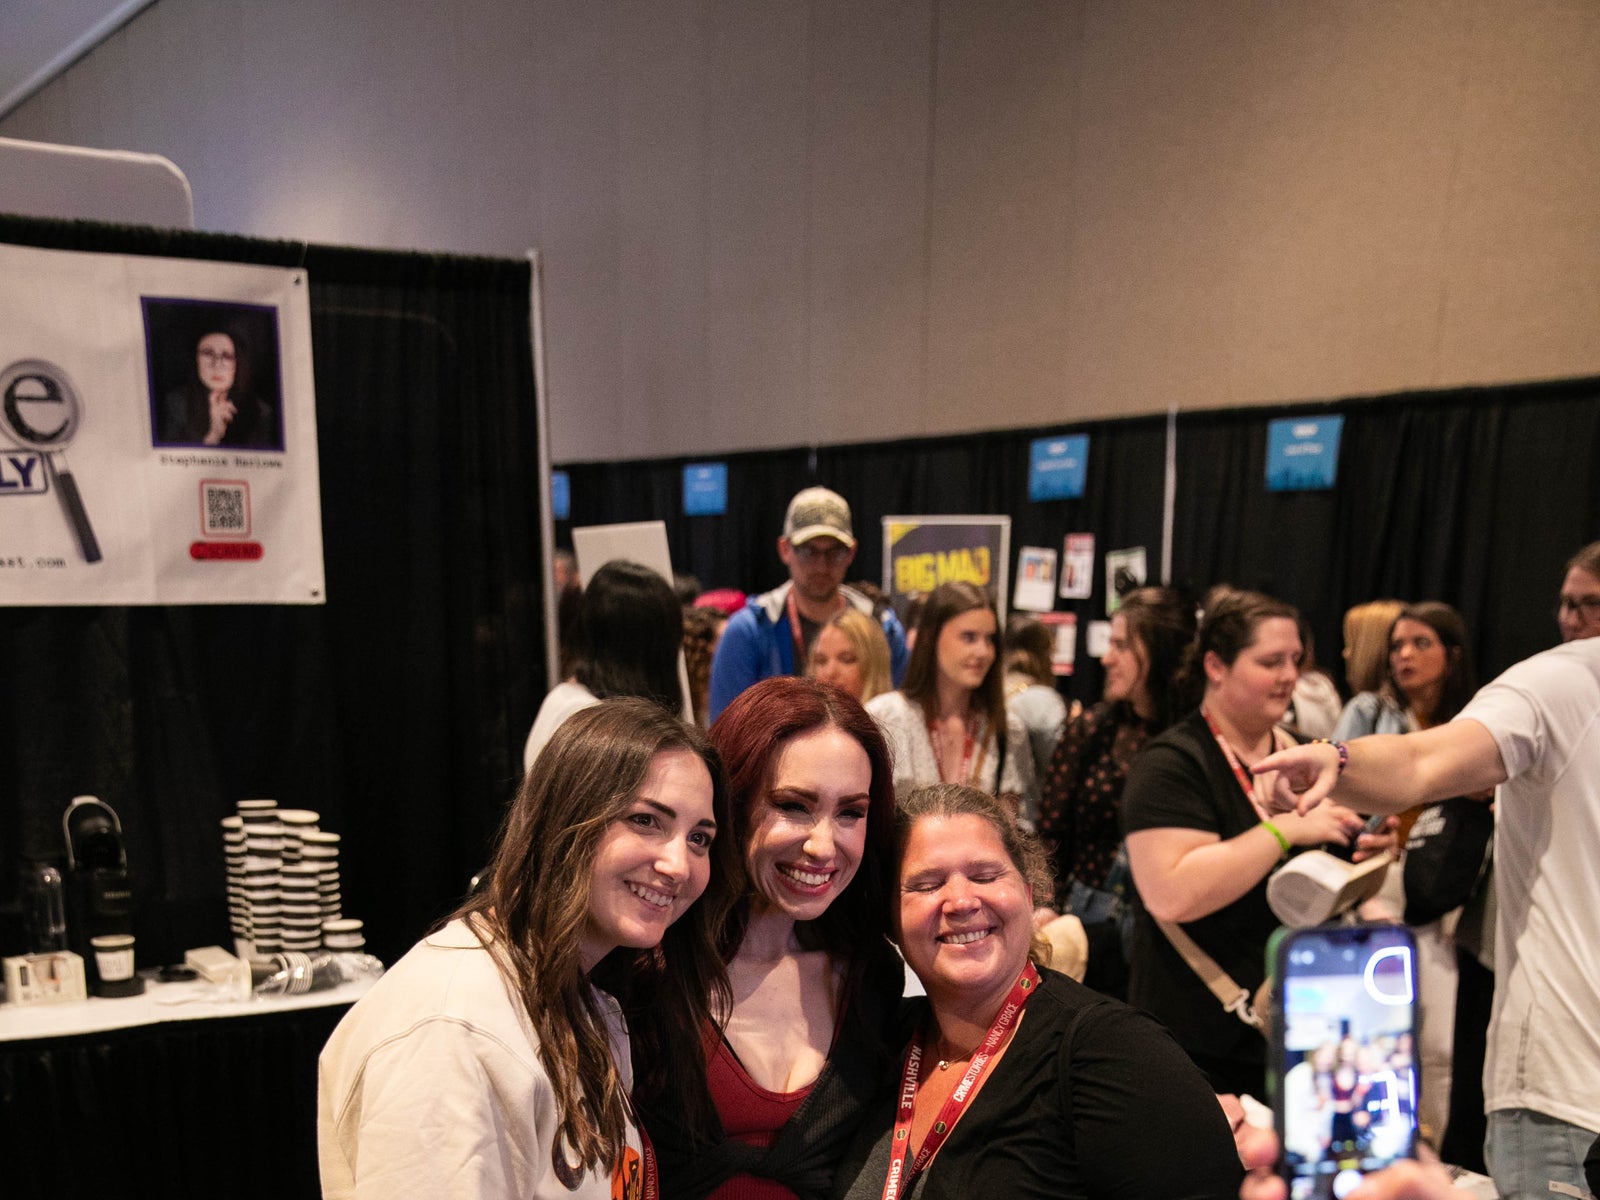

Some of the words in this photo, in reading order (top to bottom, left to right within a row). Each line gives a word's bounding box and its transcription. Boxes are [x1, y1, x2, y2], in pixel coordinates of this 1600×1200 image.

[896, 553, 936, 594] BIG
[986, 1023, 1004, 1048] NANCY
[998, 1002, 1020, 1026] GRACE
[901, 1045, 922, 1109] NASHVILLE
